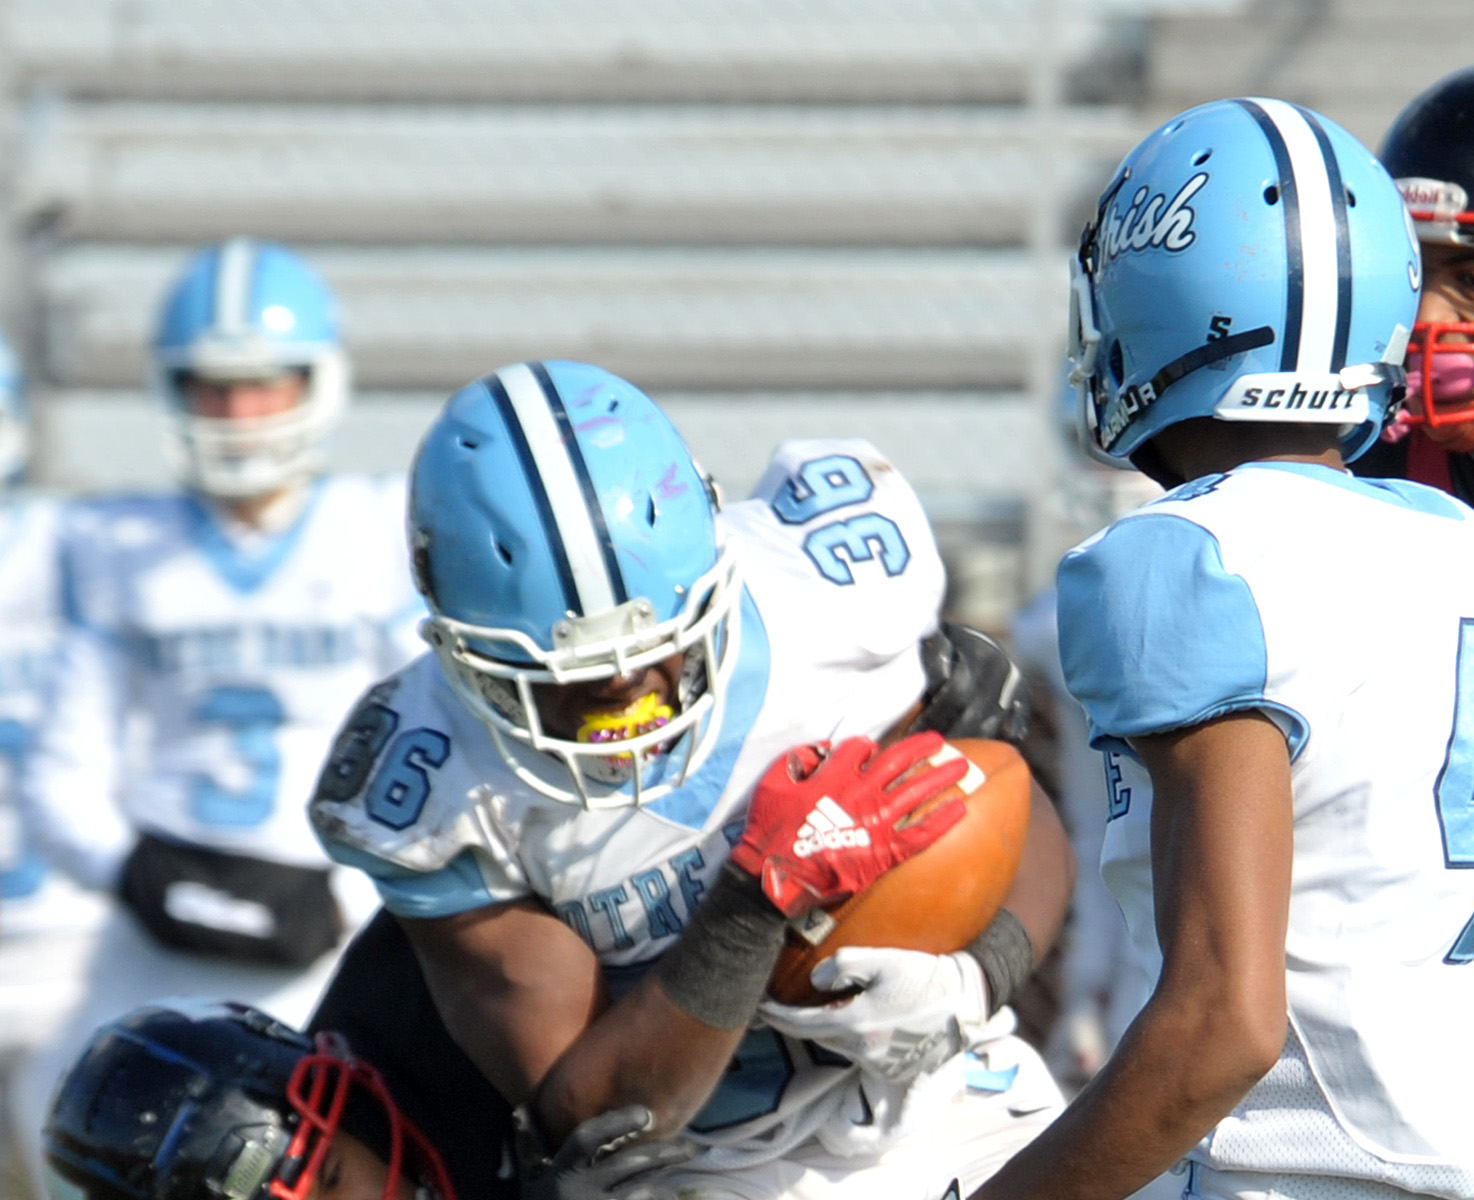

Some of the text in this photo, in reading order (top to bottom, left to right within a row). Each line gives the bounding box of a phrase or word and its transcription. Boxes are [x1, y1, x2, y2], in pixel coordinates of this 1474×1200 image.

[1099, 171, 1209, 263] rish
[1241, 382, 1358, 410] schutt
[792, 827, 871, 858] adidas
